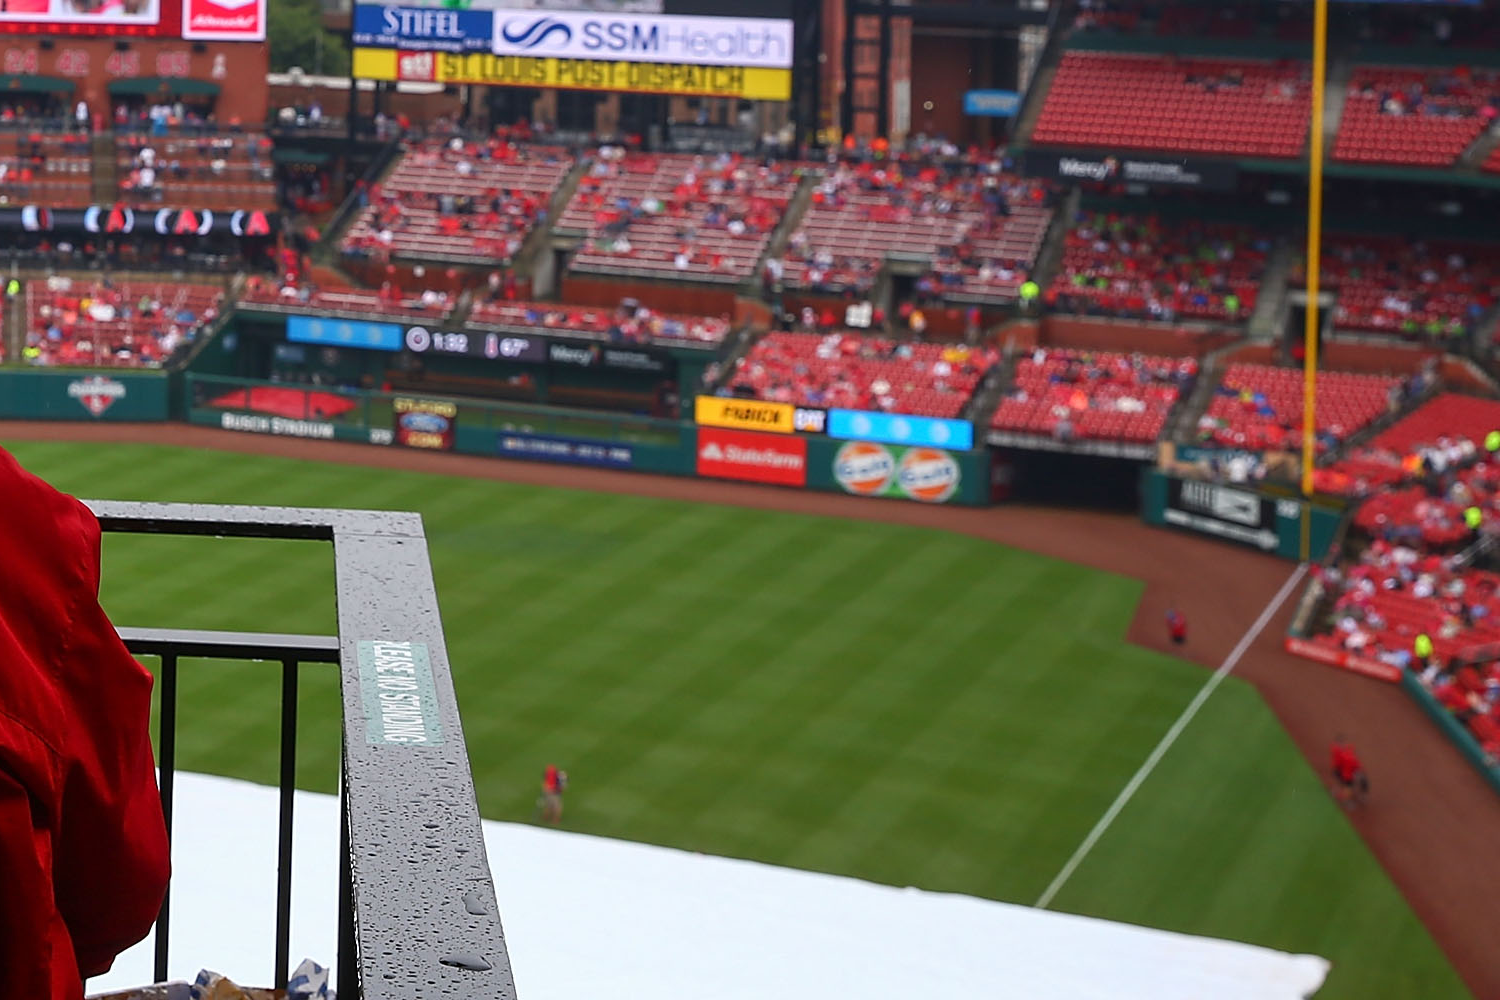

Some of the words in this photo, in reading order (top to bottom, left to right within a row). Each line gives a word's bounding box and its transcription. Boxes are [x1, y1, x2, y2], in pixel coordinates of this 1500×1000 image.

[381, 5, 467, 39] STIFEL
[221, 411, 270, 433] BUSCH
[271, 416, 335, 439] STADIUM
[377, 675, 418, 691] NO
[379, 693, 428, 743] STANDING
